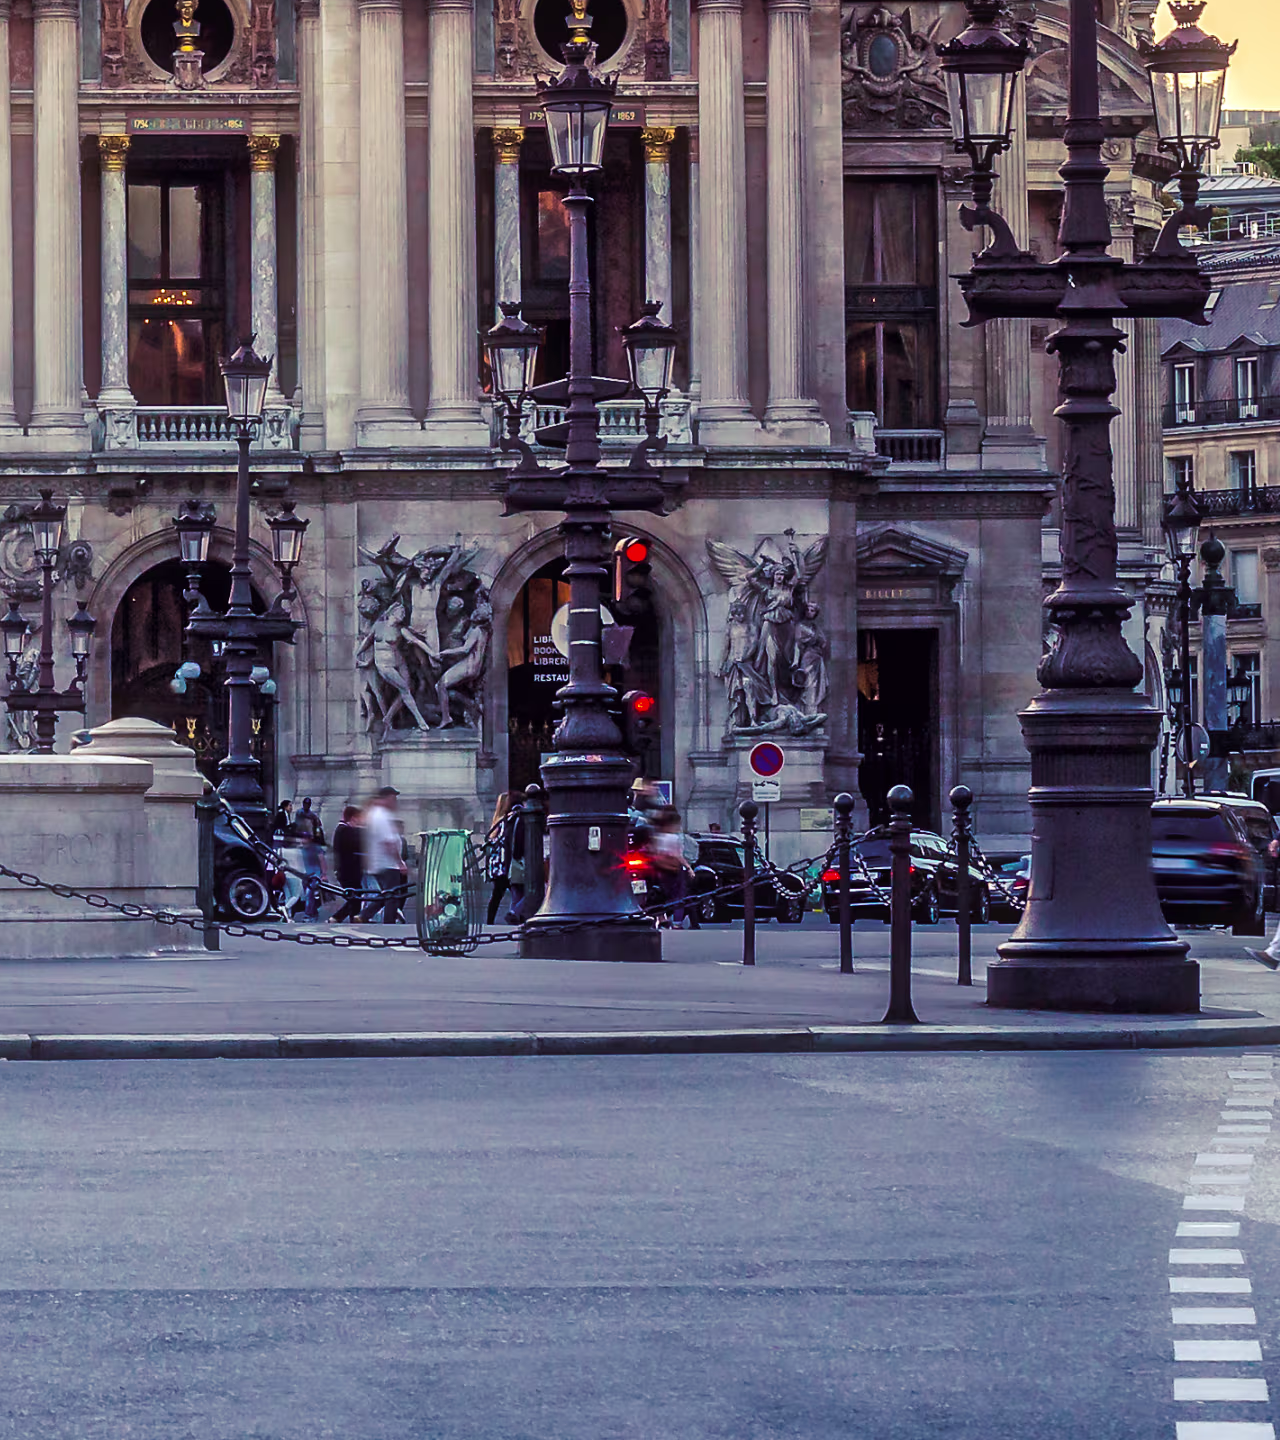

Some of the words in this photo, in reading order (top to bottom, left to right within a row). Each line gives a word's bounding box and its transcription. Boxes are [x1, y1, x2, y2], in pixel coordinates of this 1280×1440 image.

[529, 111, 544, 121] 179
[533, 646, 559, 655] BOOK
[533, 673, 569, 682] RESTAU
